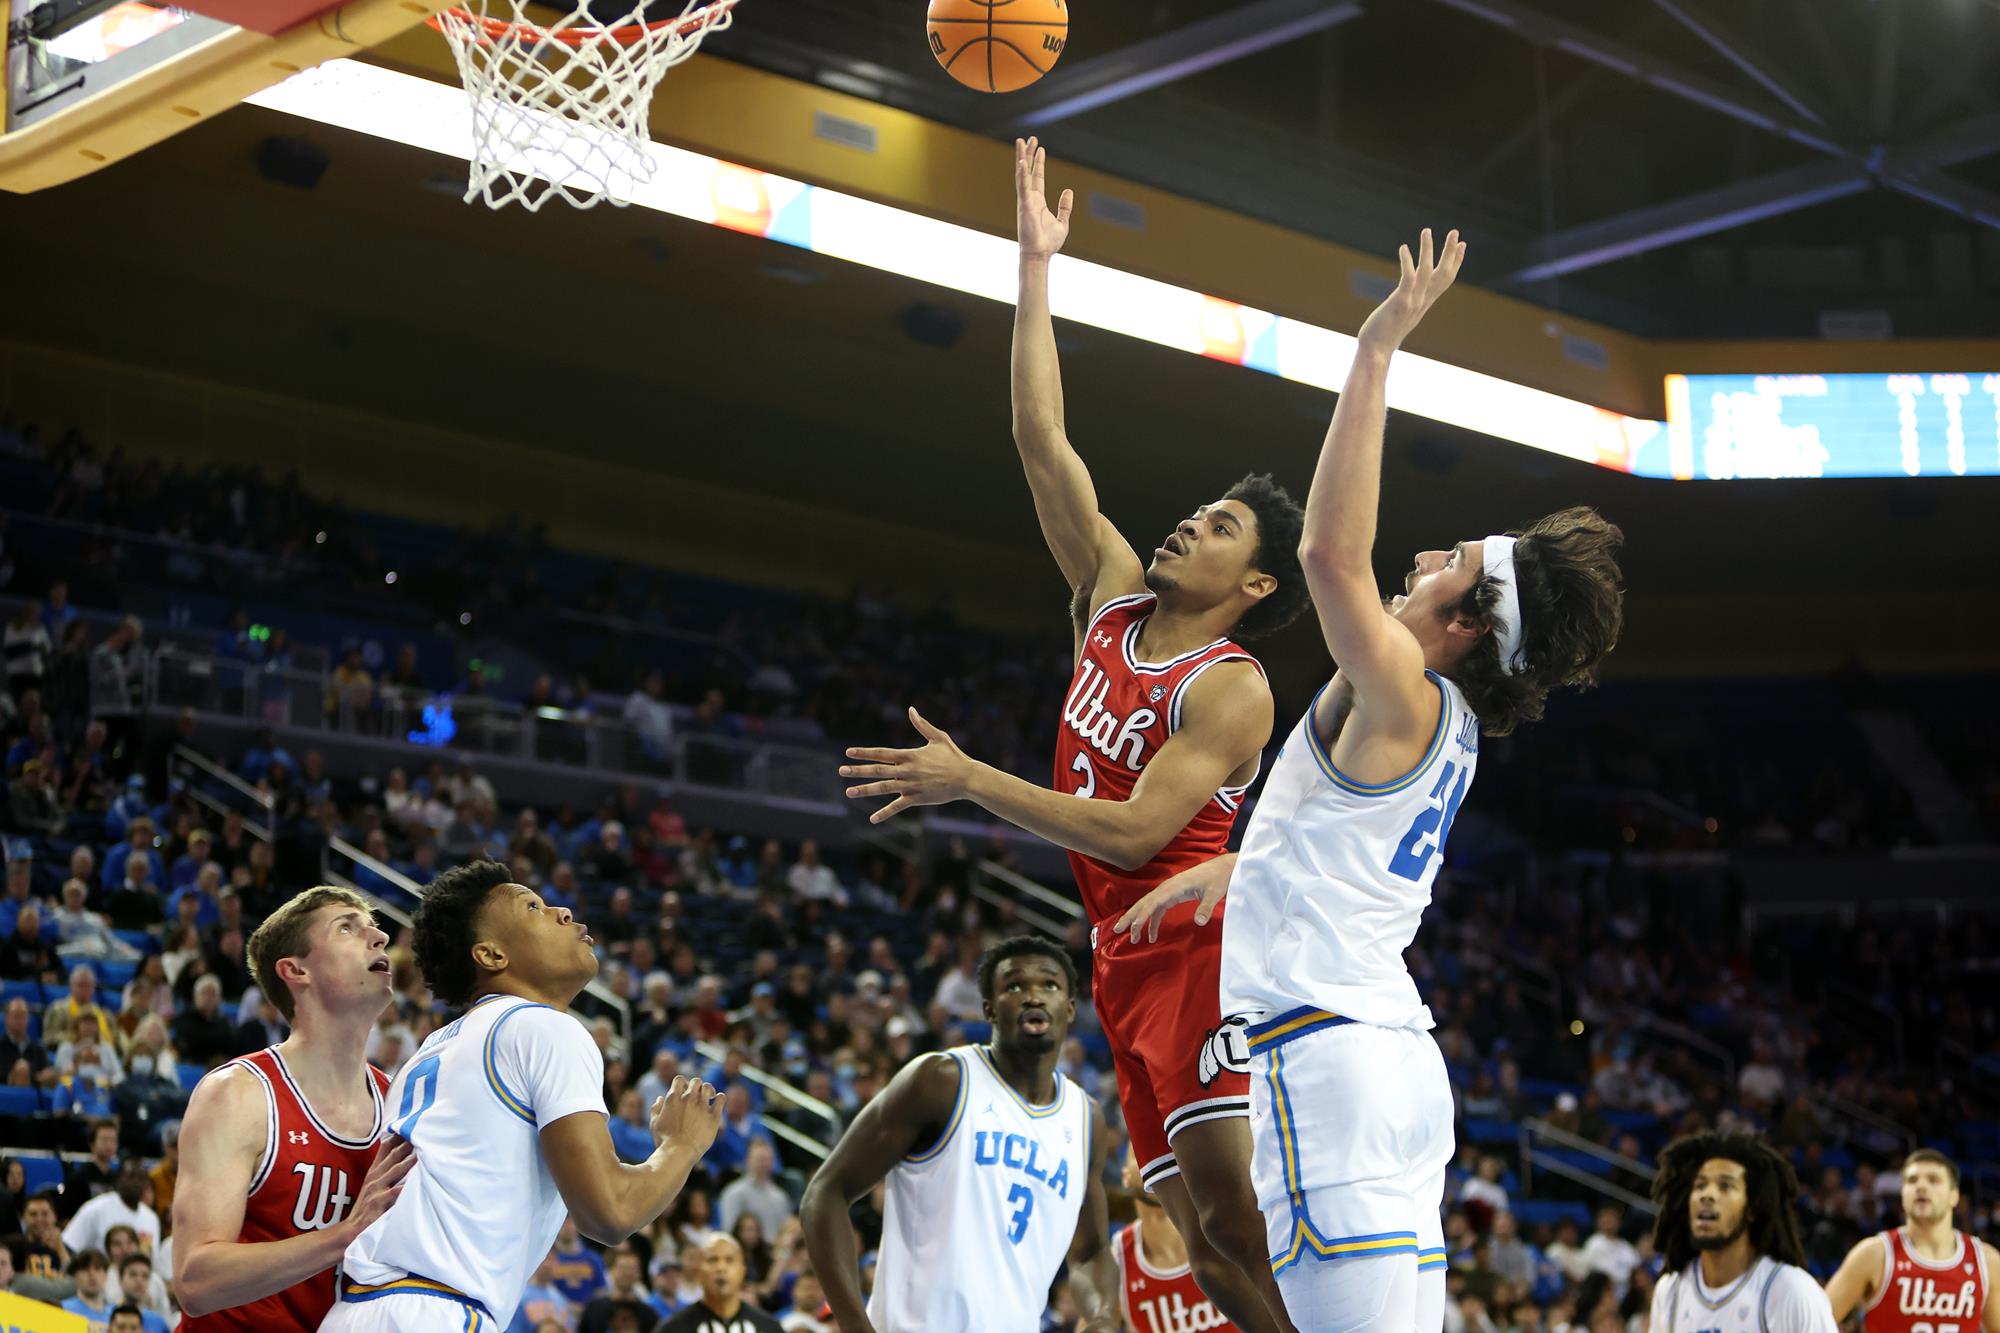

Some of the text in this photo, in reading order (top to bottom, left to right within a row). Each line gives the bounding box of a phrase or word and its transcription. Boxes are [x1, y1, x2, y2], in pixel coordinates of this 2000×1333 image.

[1063, 657, 1157, 772] Utah
[387, 1054, 441, 1143] 0
[292, 1161, 352, 1231] Ut
[974, 1131, 1069, 1201] UCLA
[1006, 1182, 1035, 1247] 3
[1137, 1291, 1229, 1333] Uta
[1896, 1276, 1977, 1320] Utah
